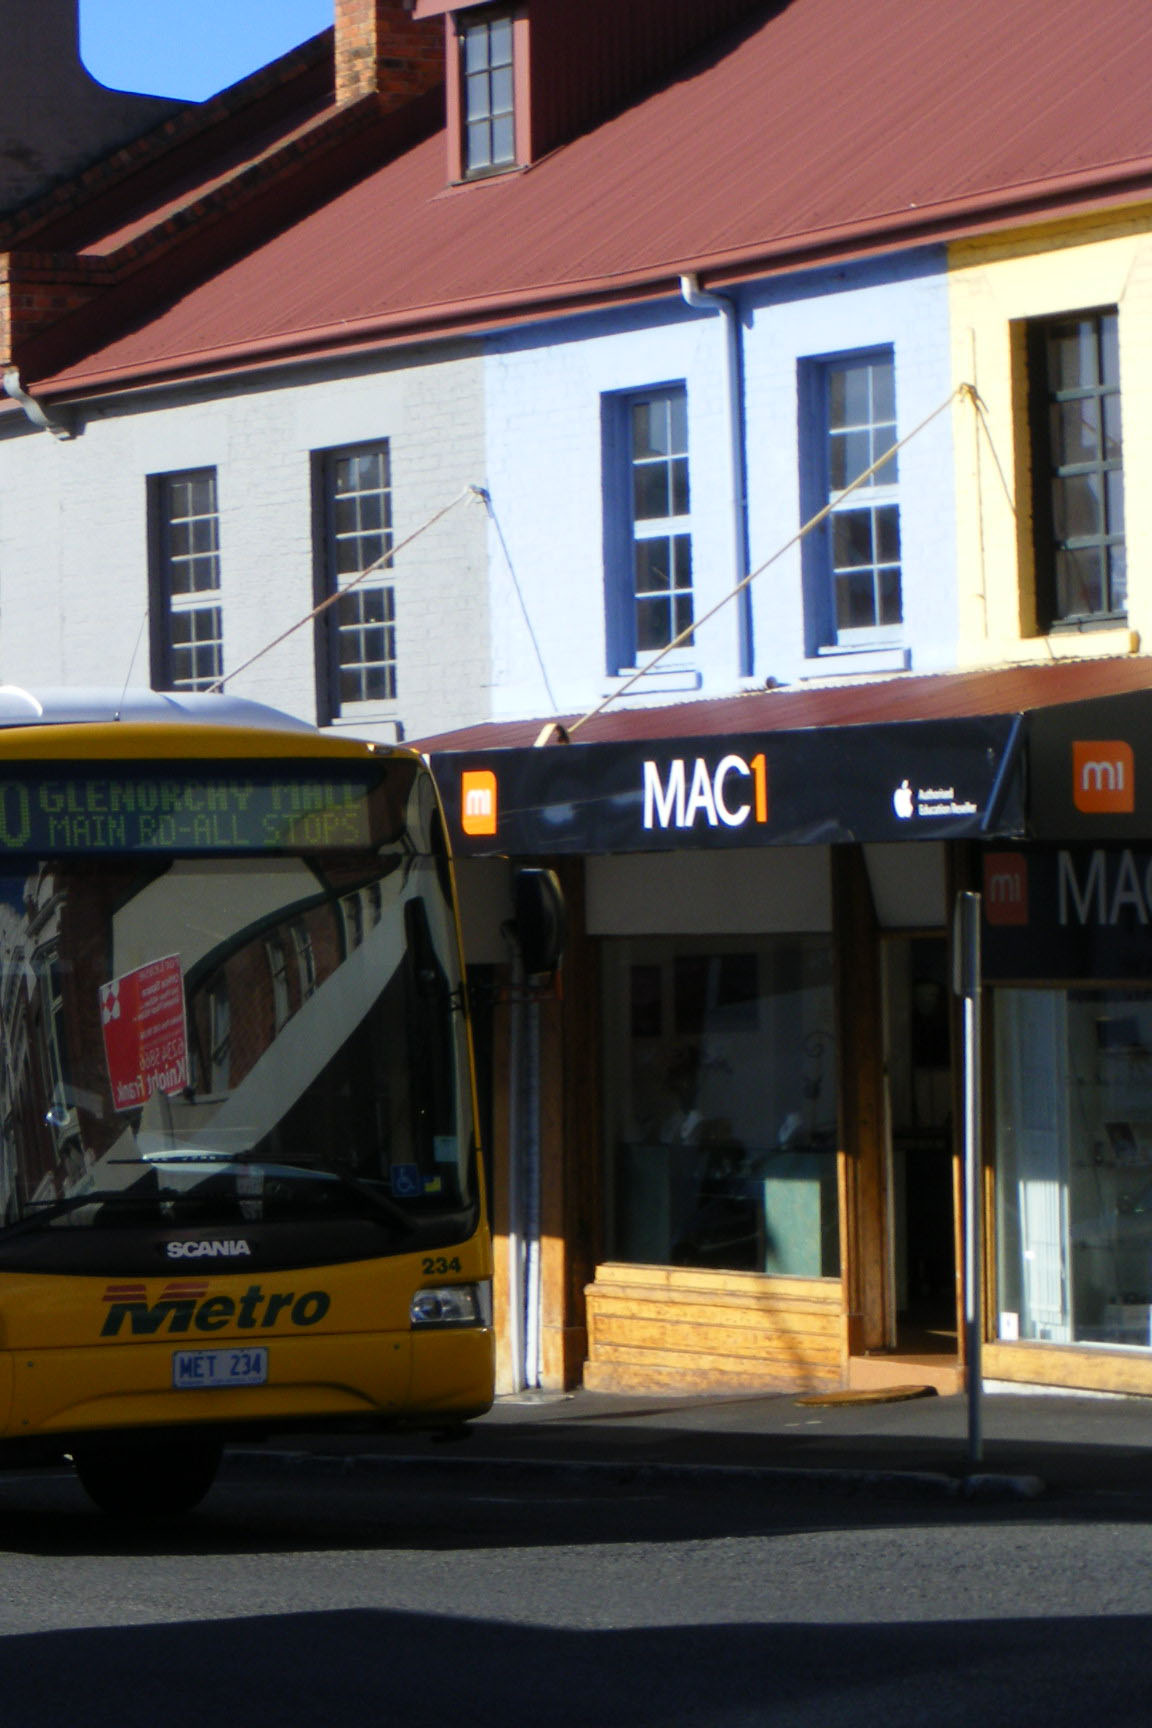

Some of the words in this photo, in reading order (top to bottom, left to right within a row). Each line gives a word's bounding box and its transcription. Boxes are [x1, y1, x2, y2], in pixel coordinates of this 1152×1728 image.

[39, 779, 254, 812] GLENORCHY
[272, 782, 362, 811] MALL
[644, 754, 767, 829] MAC1
[50, 815, 127, 846] MAIN
[262, 813, 360, 846] STOPS
[167, 1239, 251, 1259] SCANIA
[422, 1257, 462, 1276] 234
[179, 1355, 217, 1378] MET
[230, 1353, 262, 1376] 234
